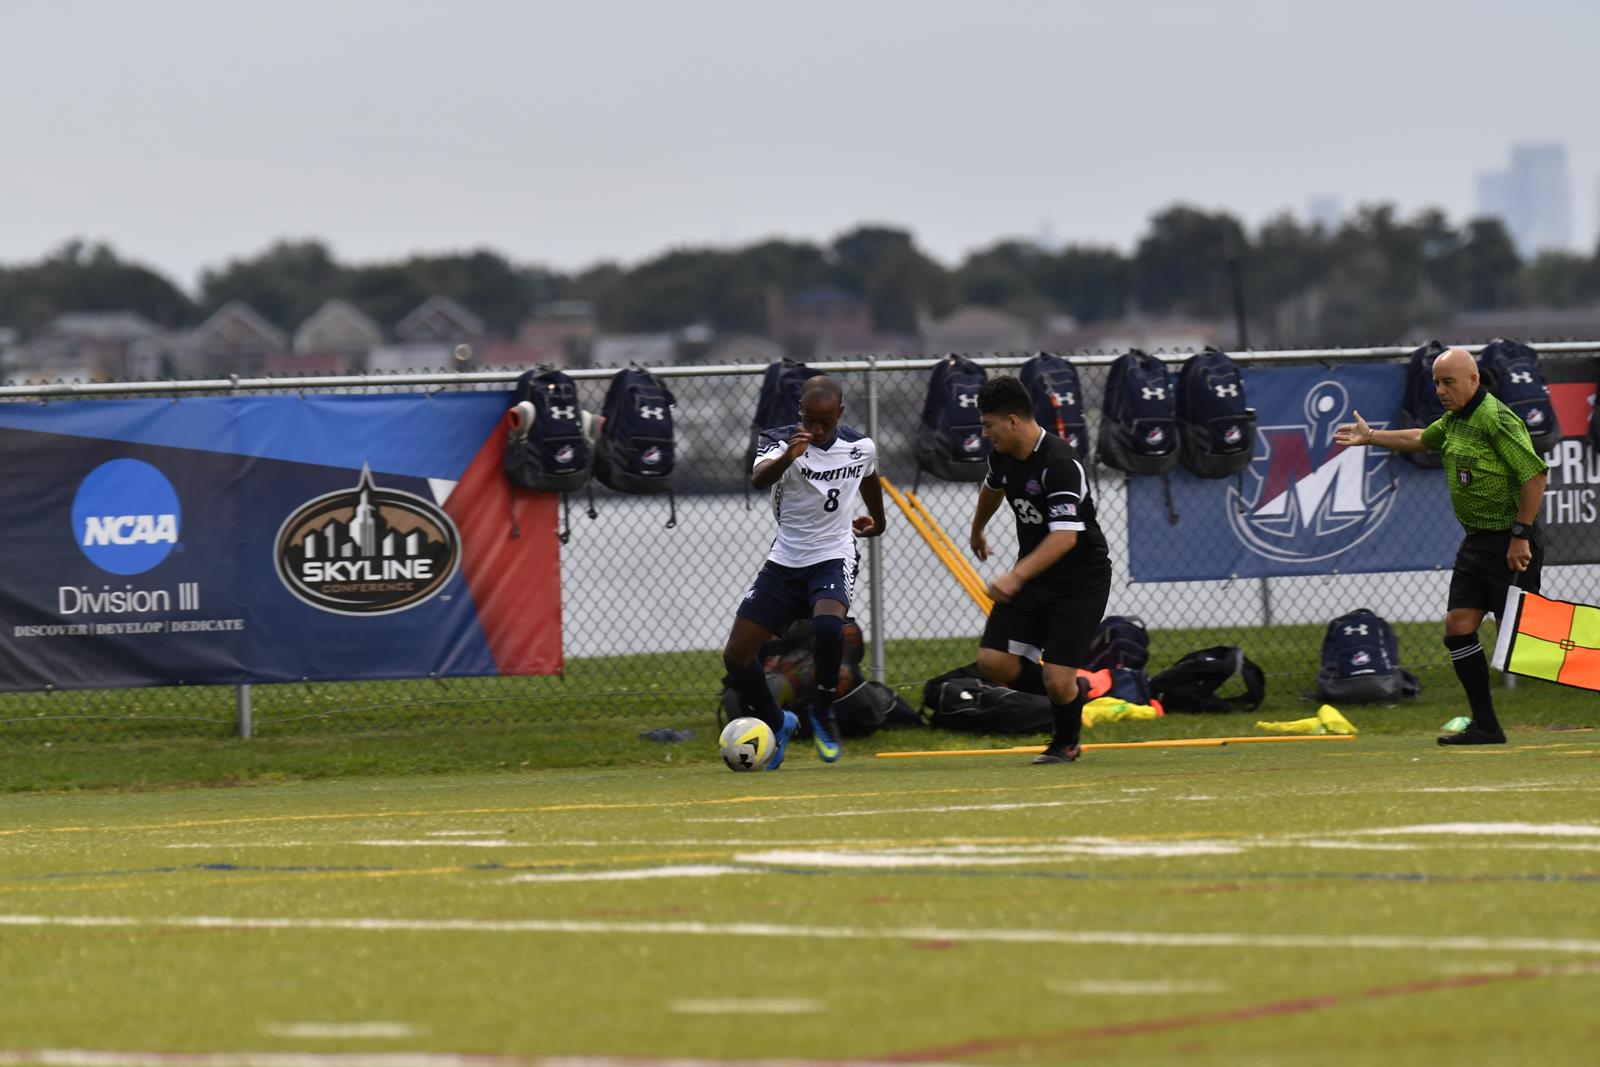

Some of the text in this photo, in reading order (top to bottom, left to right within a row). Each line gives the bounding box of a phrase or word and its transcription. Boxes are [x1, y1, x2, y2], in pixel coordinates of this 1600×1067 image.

[801, 464, 864, 482] MARITIME
[823, 488, 841, 513] 8
[1543, 488, 1597, 524] THIS
[83, 513, 179, 546] NCAA
[302, 558, 433, 582] SKYLINE
[58, 582, 199, 615] Division III
[321, 581, 416, 593] CONFERENCE
[14, 618, 245, 638] DISCOVER DEVELOP DEDICATE
